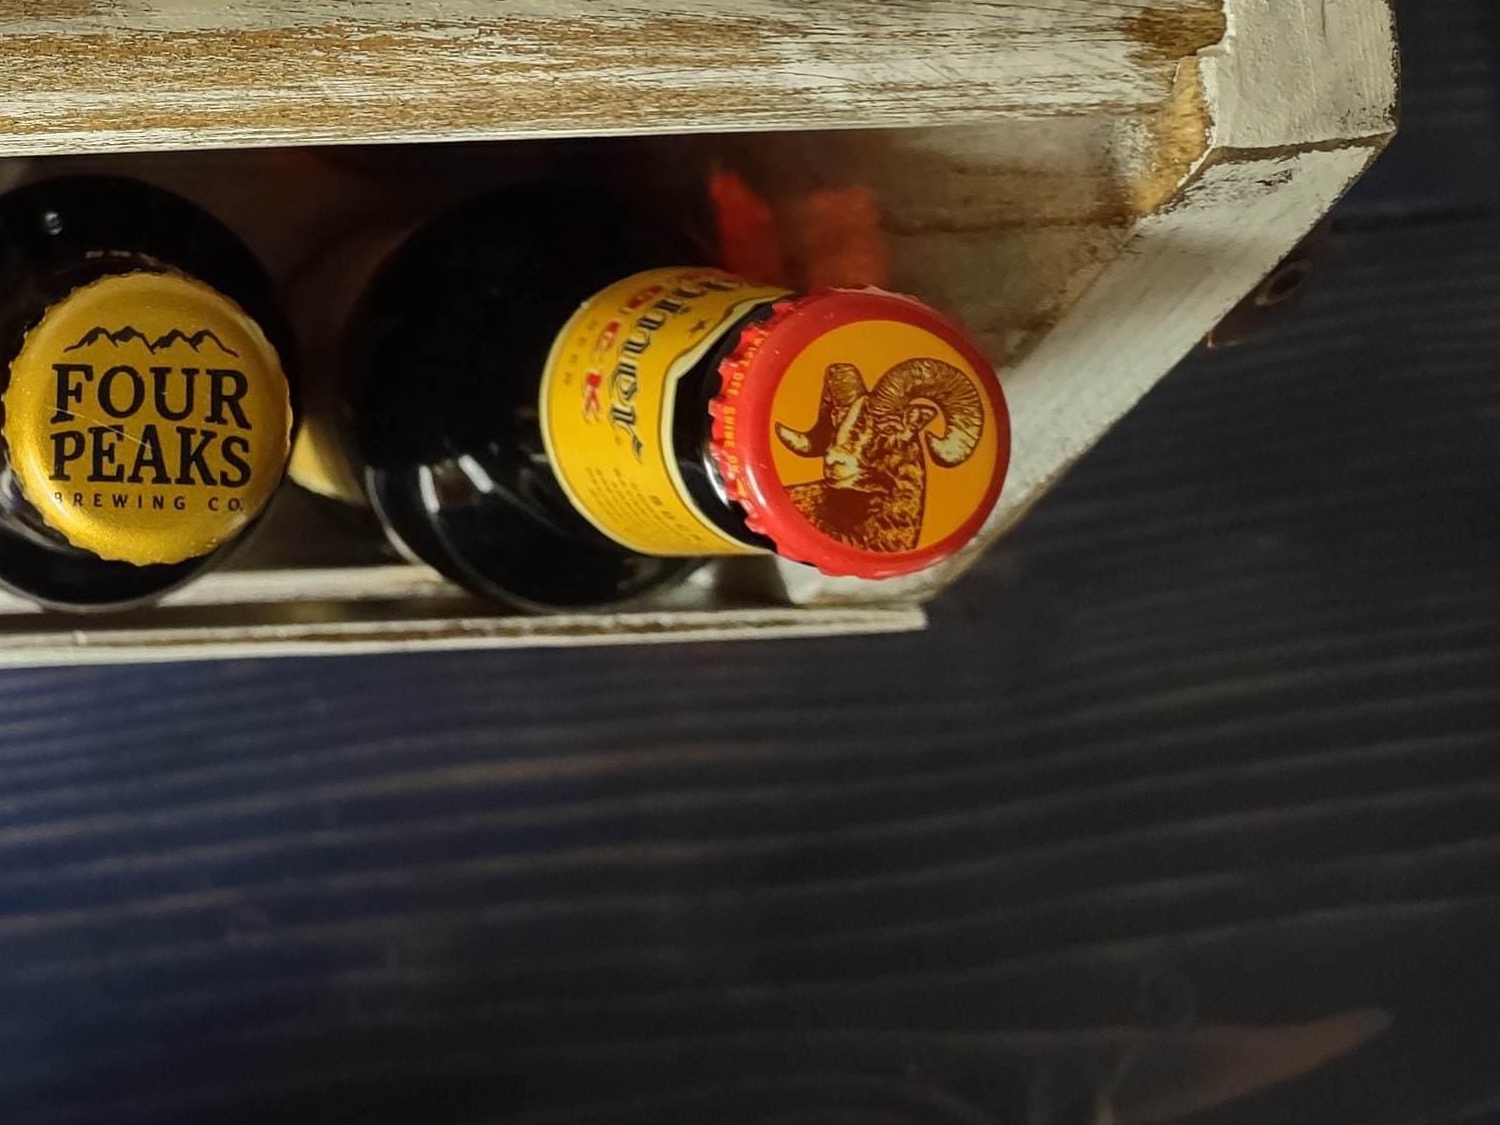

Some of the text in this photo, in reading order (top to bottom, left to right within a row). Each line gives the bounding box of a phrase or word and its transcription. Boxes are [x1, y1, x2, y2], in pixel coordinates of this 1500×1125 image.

[50, 364, 252, 429] FOUR
[723, 406, 736, 448] SHINE
[49, 424, 251, 488] PEAKS
[54, 492, 186, 511] BREWING
